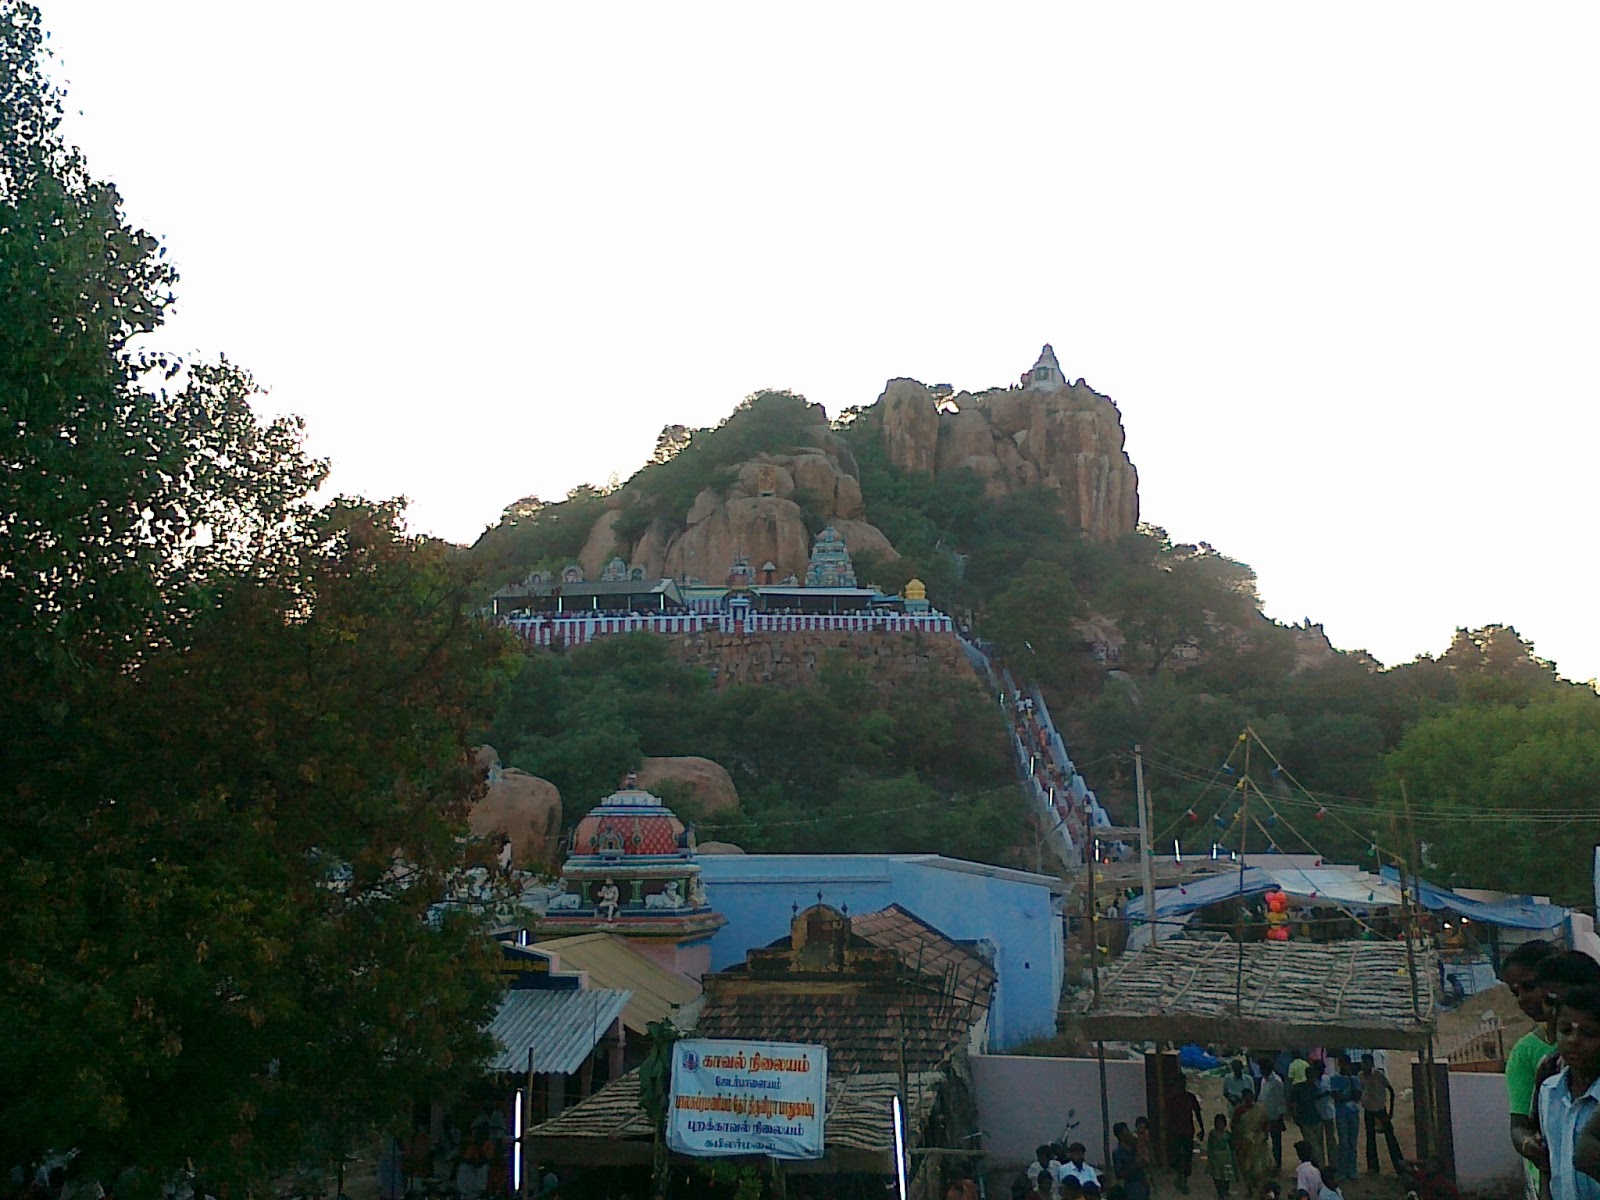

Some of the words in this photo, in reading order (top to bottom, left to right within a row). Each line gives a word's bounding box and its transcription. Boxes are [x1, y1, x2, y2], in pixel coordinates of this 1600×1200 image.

[703, 1051, 746, 1069] காவல்
[748, 1052, 810, 1073] நிலையம்
[688, 1118, 750, 1133] புறக்காவல்
[752, 1120, 804, 1136] நிலையம்
